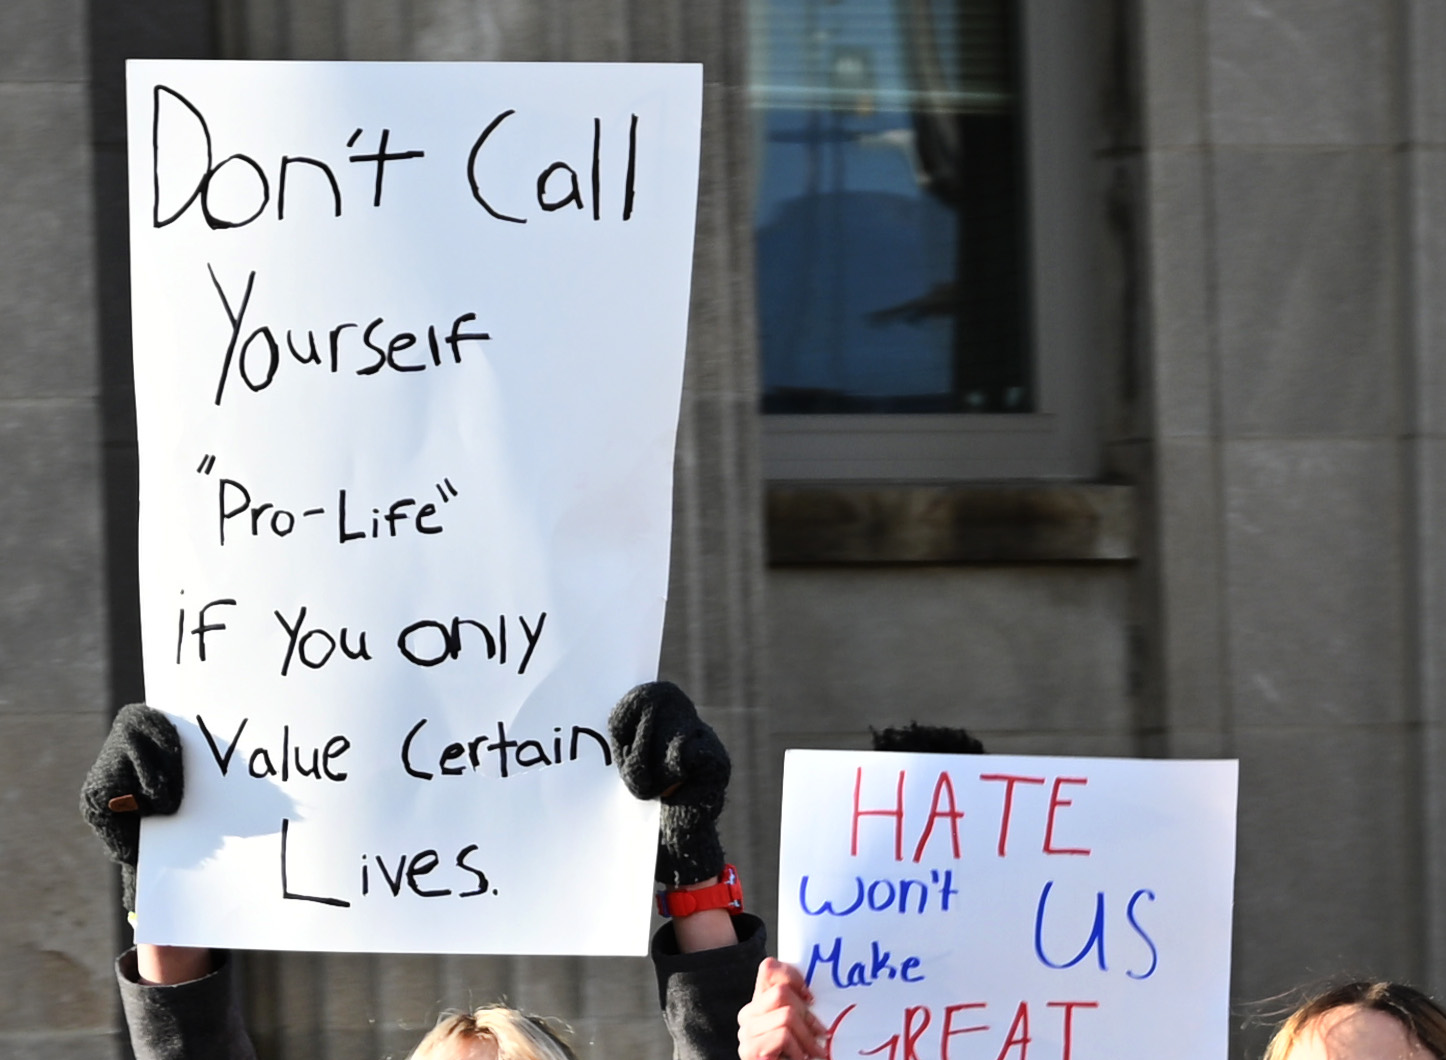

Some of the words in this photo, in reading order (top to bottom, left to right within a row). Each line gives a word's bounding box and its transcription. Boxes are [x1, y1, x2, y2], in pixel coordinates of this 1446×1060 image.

[152, 84, 425, 230] Don't
[467, 108, 638, 224] Call
[206, 261, 492, 407] Yourself
[175, 589, 237, 665] if
[397, 611, 547, 675] only
[195, 713, 350, 782] Value
[401, 718, 613, 780] Certain
[850, 766, 1092, 863] HATE
[280, 818, 499, 908] Lives.
[803, 936, 926, 989] Make
[1034, 880, 1159, 980] US
